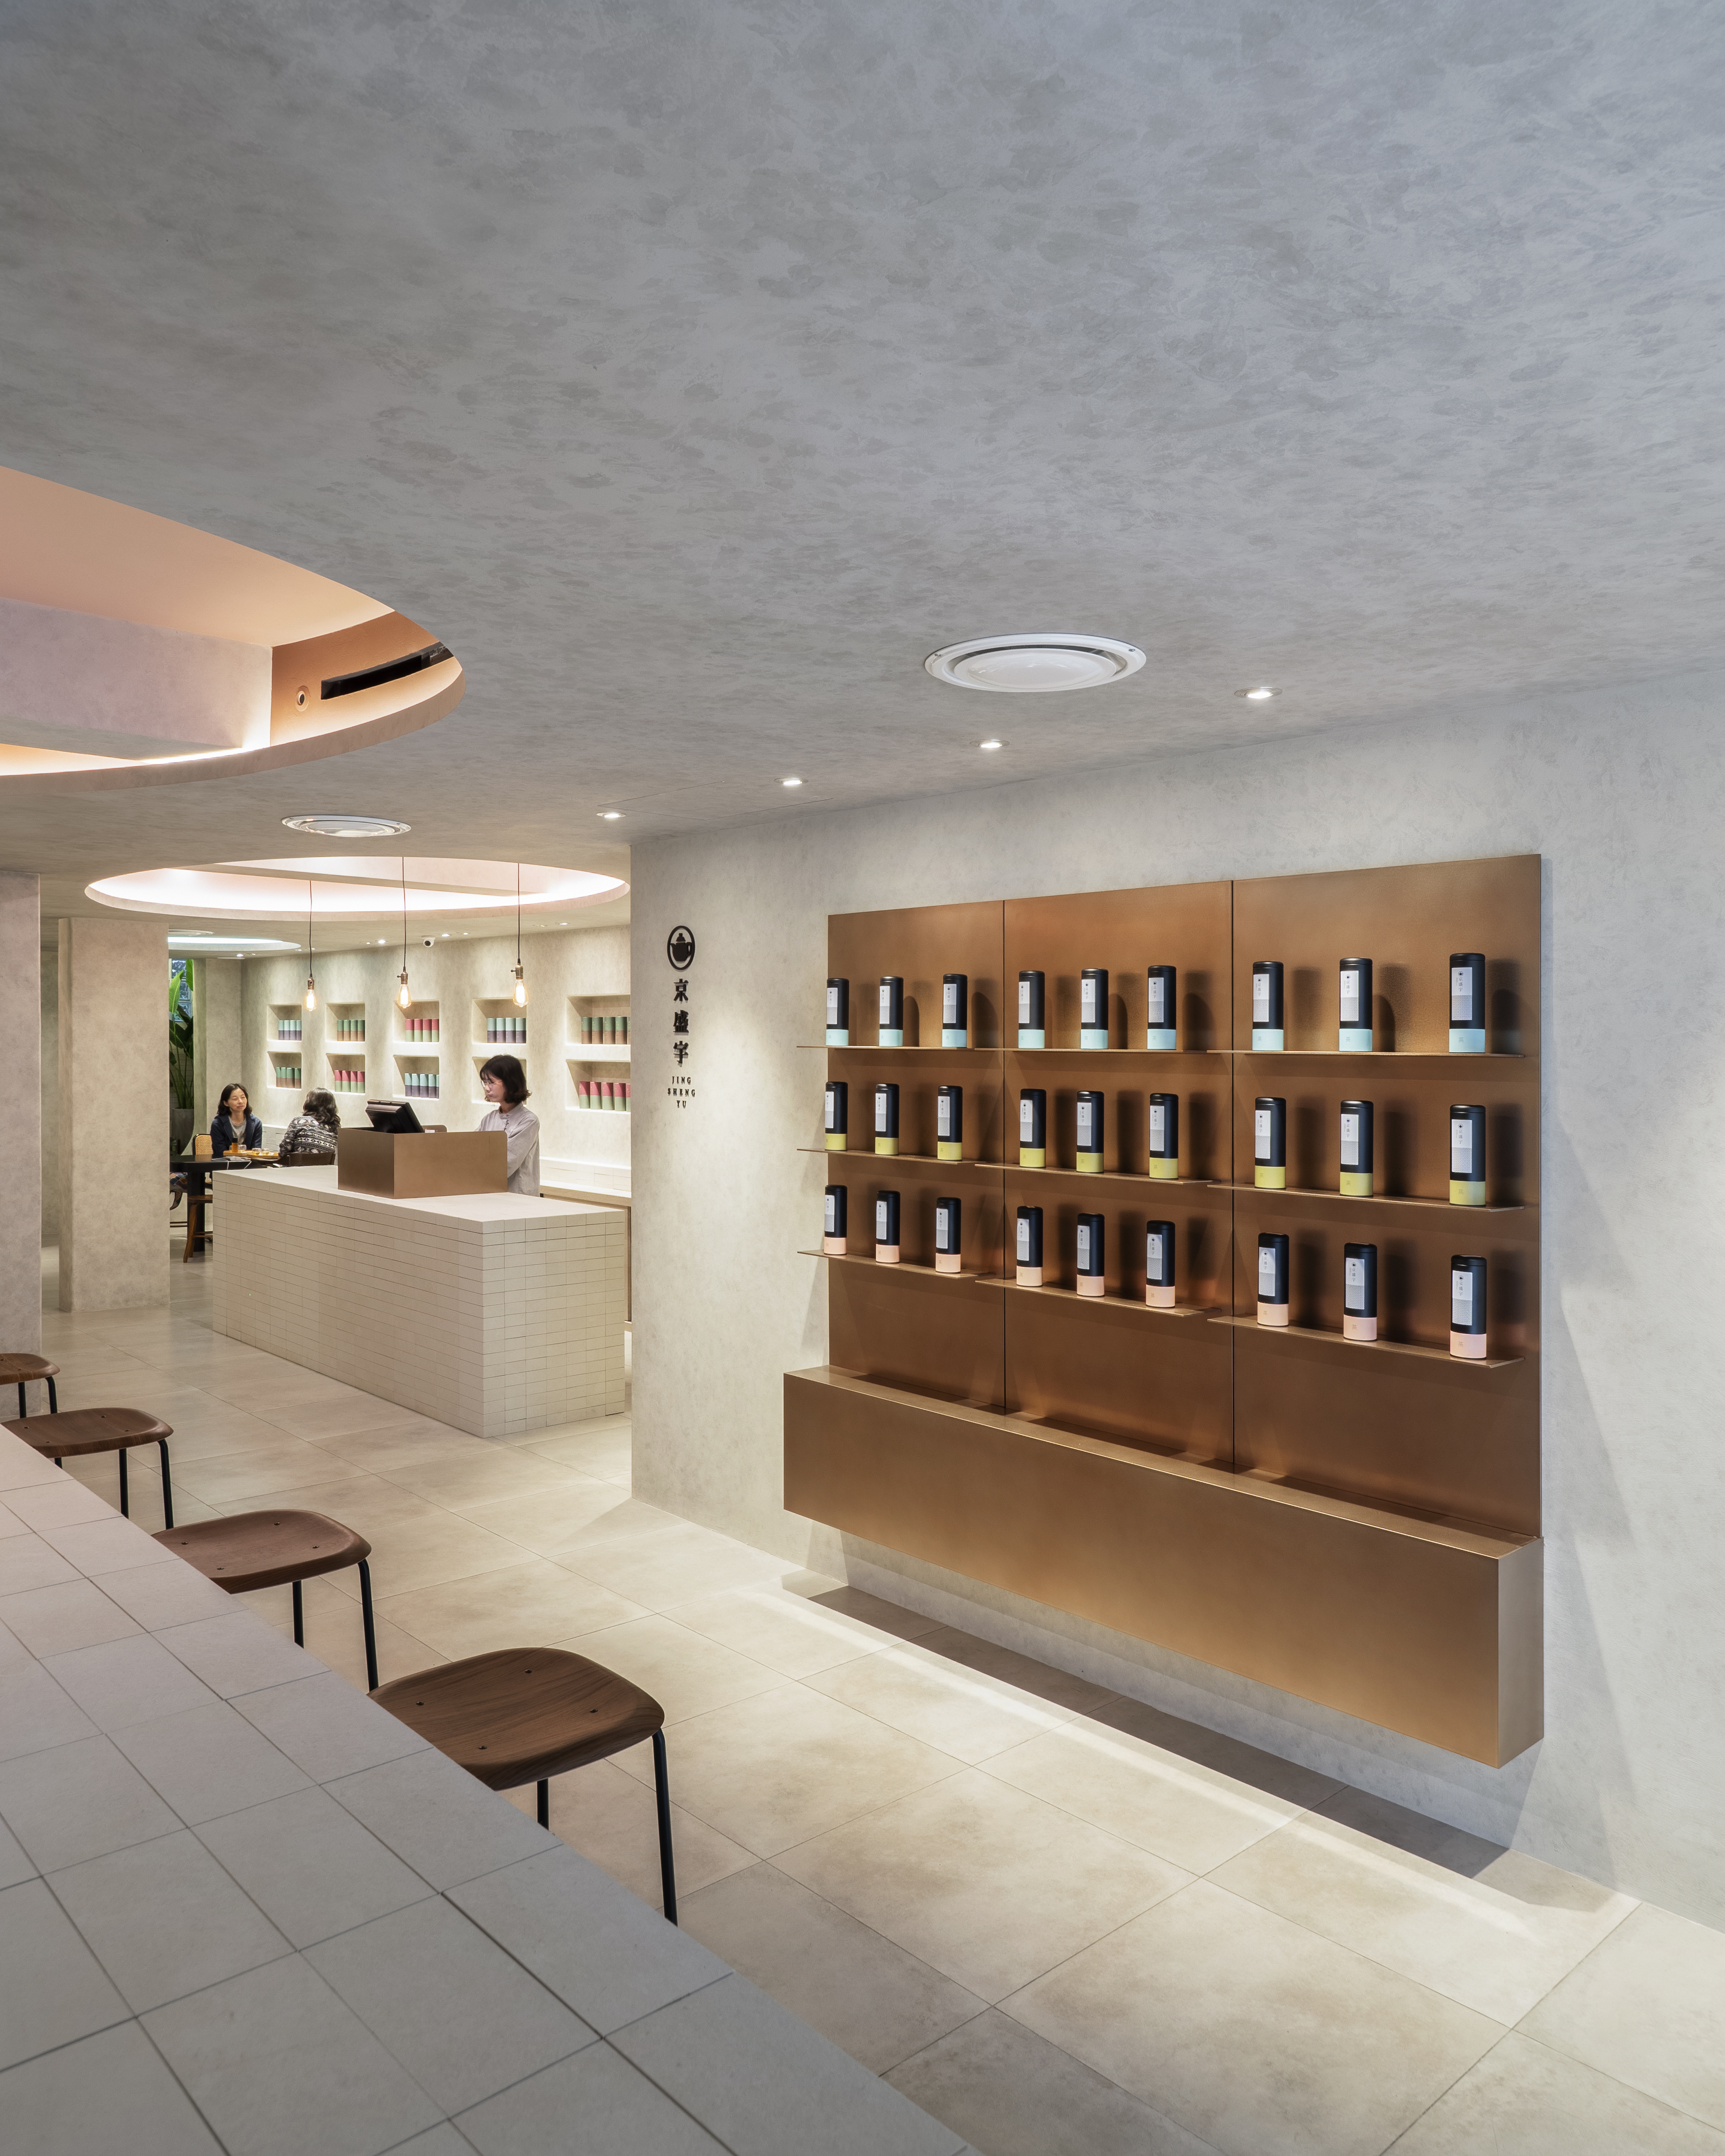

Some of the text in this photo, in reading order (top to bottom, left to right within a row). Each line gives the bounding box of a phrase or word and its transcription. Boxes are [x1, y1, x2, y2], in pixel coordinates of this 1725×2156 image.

[673, 979, 689, 1065] 京盛宇
[668, 1088, 695, 1096] SHENG
